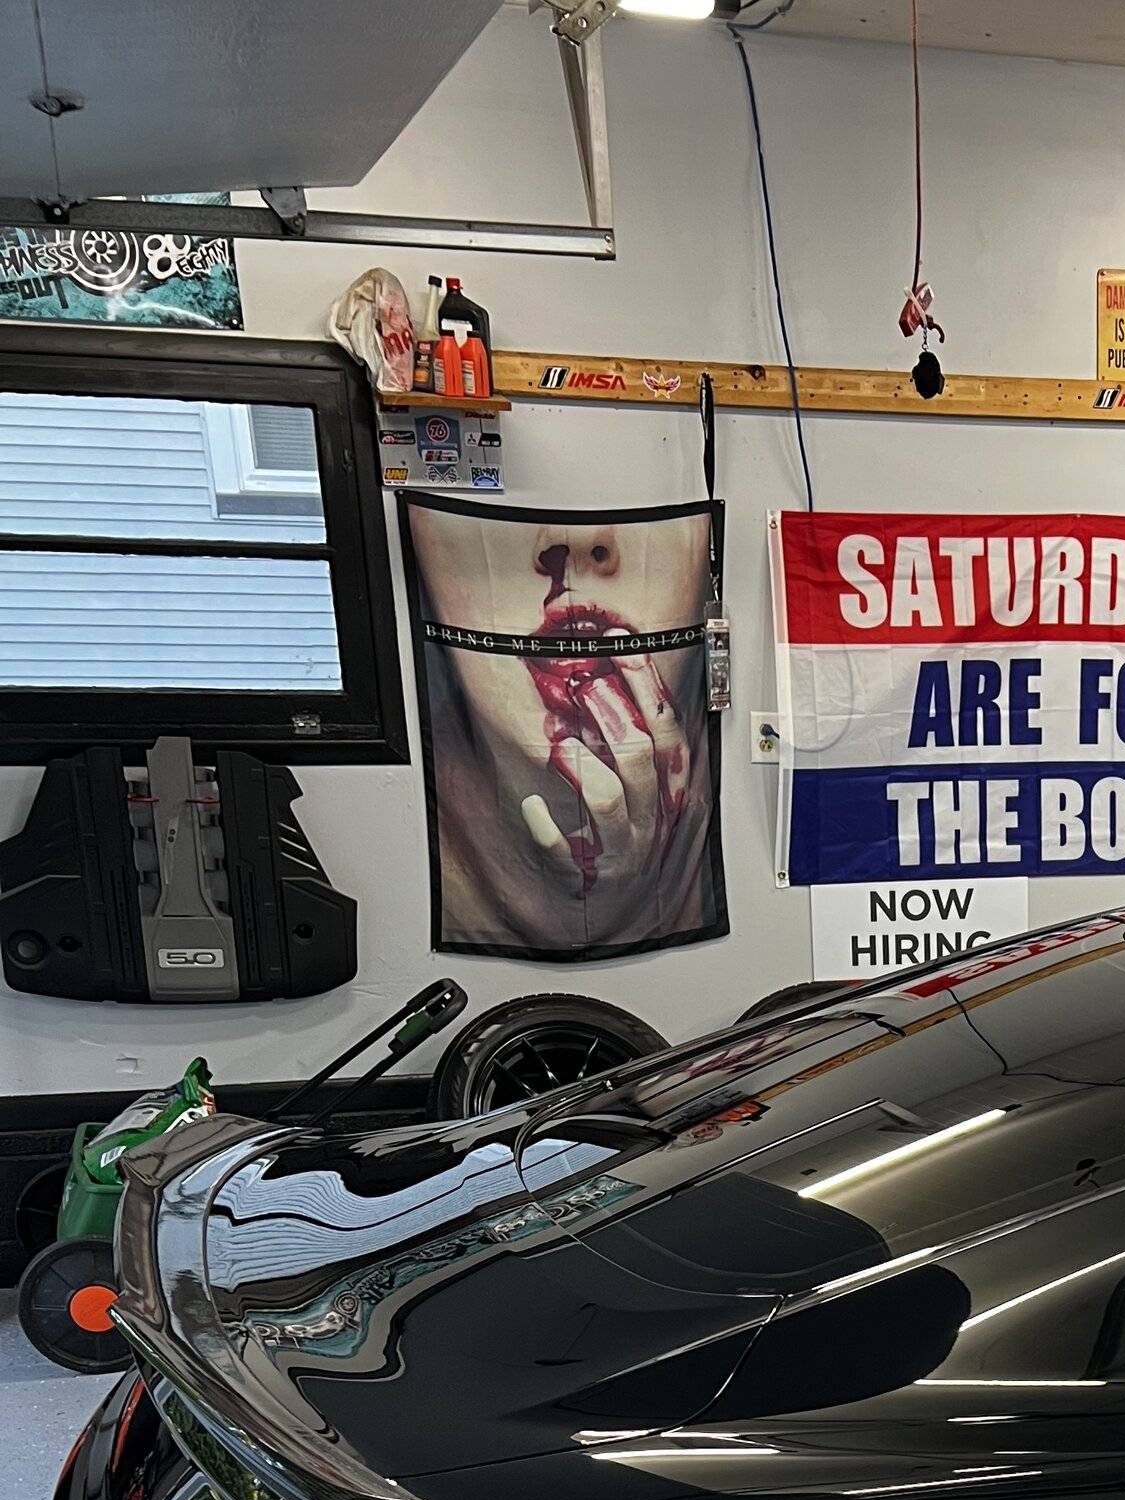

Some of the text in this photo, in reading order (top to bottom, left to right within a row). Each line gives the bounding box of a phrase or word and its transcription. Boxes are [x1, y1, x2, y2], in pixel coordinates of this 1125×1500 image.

[1115, 318, 1125, 342] IS
[568, 372, 627, 390] IMSA
[429, 423, 447, 438] 76
[426, 624, 495, 648] BRING
[511, 637, 542, 652] ME
[556, 640, 599, 653] THE
[907, 658, 1042, 748] ARE
[886, 779, 1021, 867] THE
[869, 887, 974, 922] NOW
[166, 952, 216, 965] 5.0
